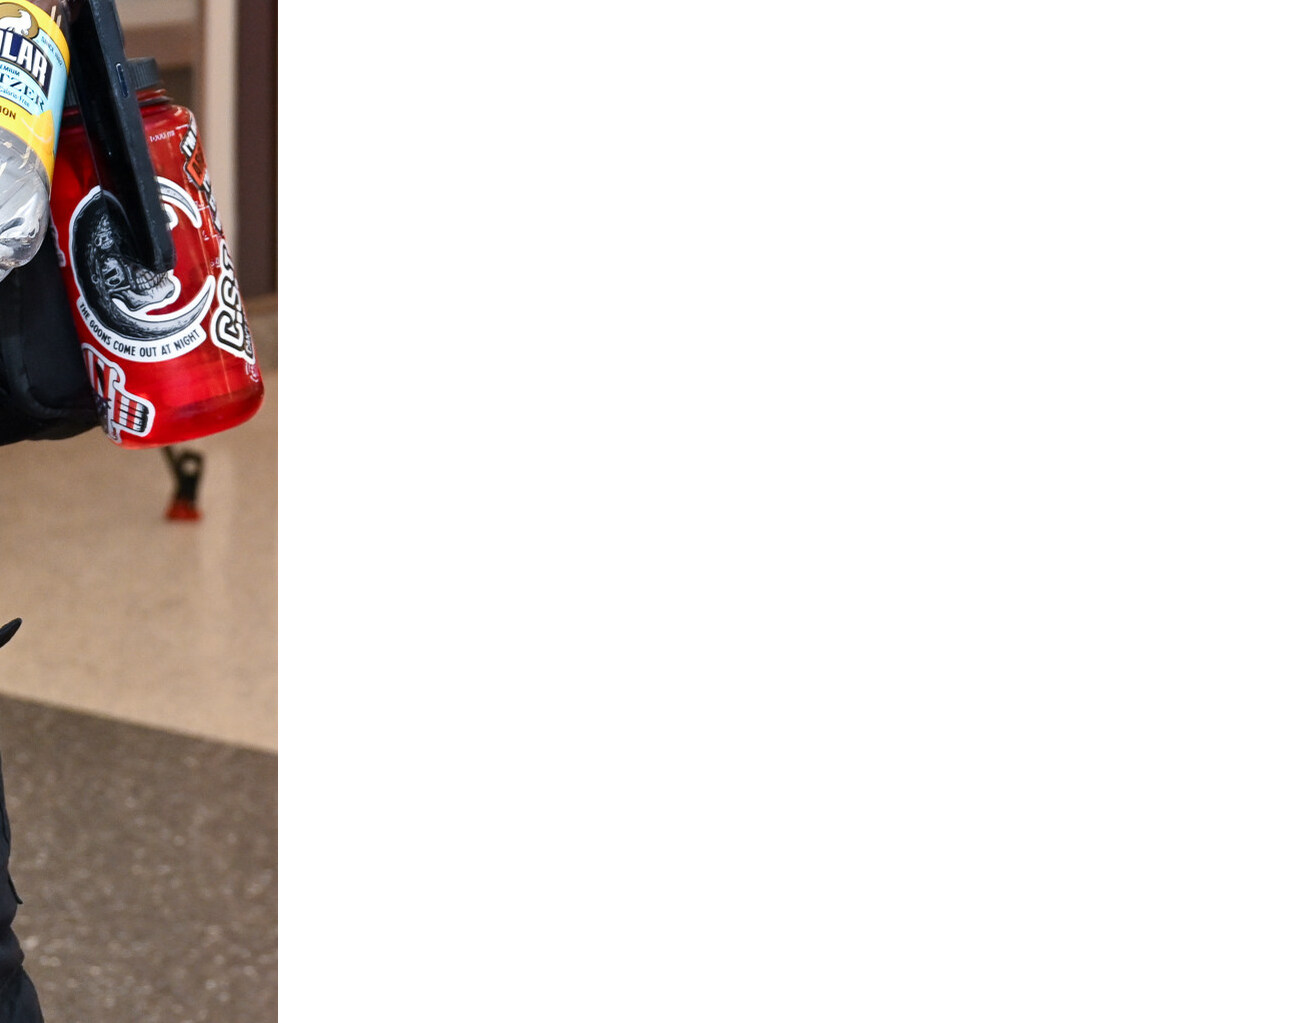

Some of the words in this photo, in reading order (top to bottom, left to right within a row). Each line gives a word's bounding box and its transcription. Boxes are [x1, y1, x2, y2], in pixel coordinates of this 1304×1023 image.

[79, 303, 90, 318] THE
[89, 320, 112, 346] GOONS
[113, 340, 136, 357] COME
[139, 347, 157, 358] OUT
[161, 344, 172, 356] AT
[173, 329, 201, 351] NIGHT
